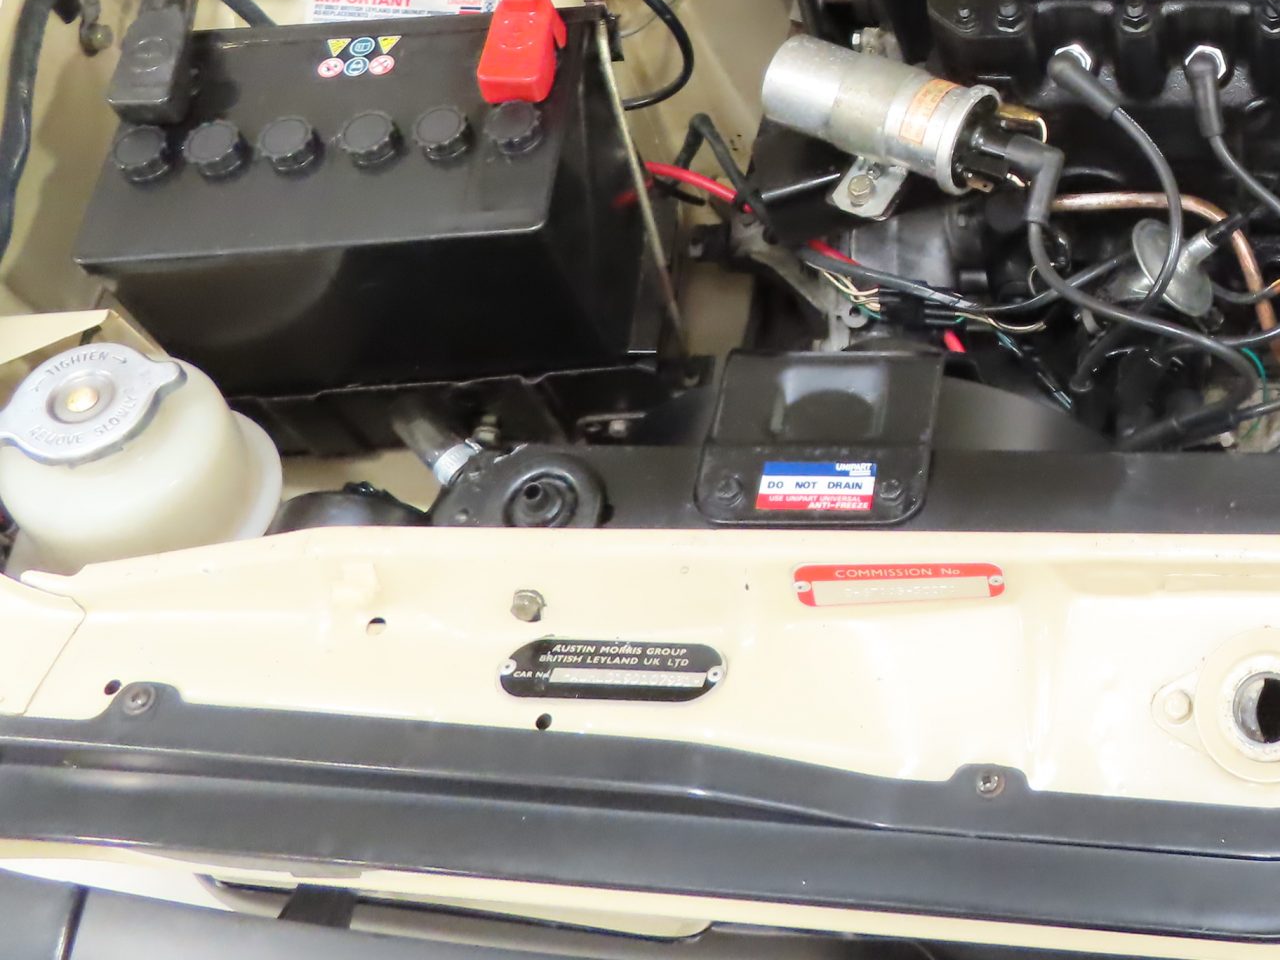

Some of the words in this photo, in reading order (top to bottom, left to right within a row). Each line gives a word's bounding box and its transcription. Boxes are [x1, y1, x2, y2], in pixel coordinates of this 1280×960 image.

[46, 350, 109, 376] TIGHTEN
[835, 462, 872, 471] UNIPART
[767, 481, 784, 489] DO
[795, 481, 818, 489] NOT
[827, 481, 863, 490] DRAIN
[834, 568, 933, 579] COMMISSION
[552, 644, 596, 654] AUSTIN
[599, 645, 642, 655] MORRIS
[646, 647, 687, 657] GROUP
[539, 654, 582, 664] BRITISH
[587, 655, 640, 665] LEYLAND
[643, 656, 662, 666] UK
[667, 657, 689, 667] LTD
[513, 670, 533, 678] CAR
